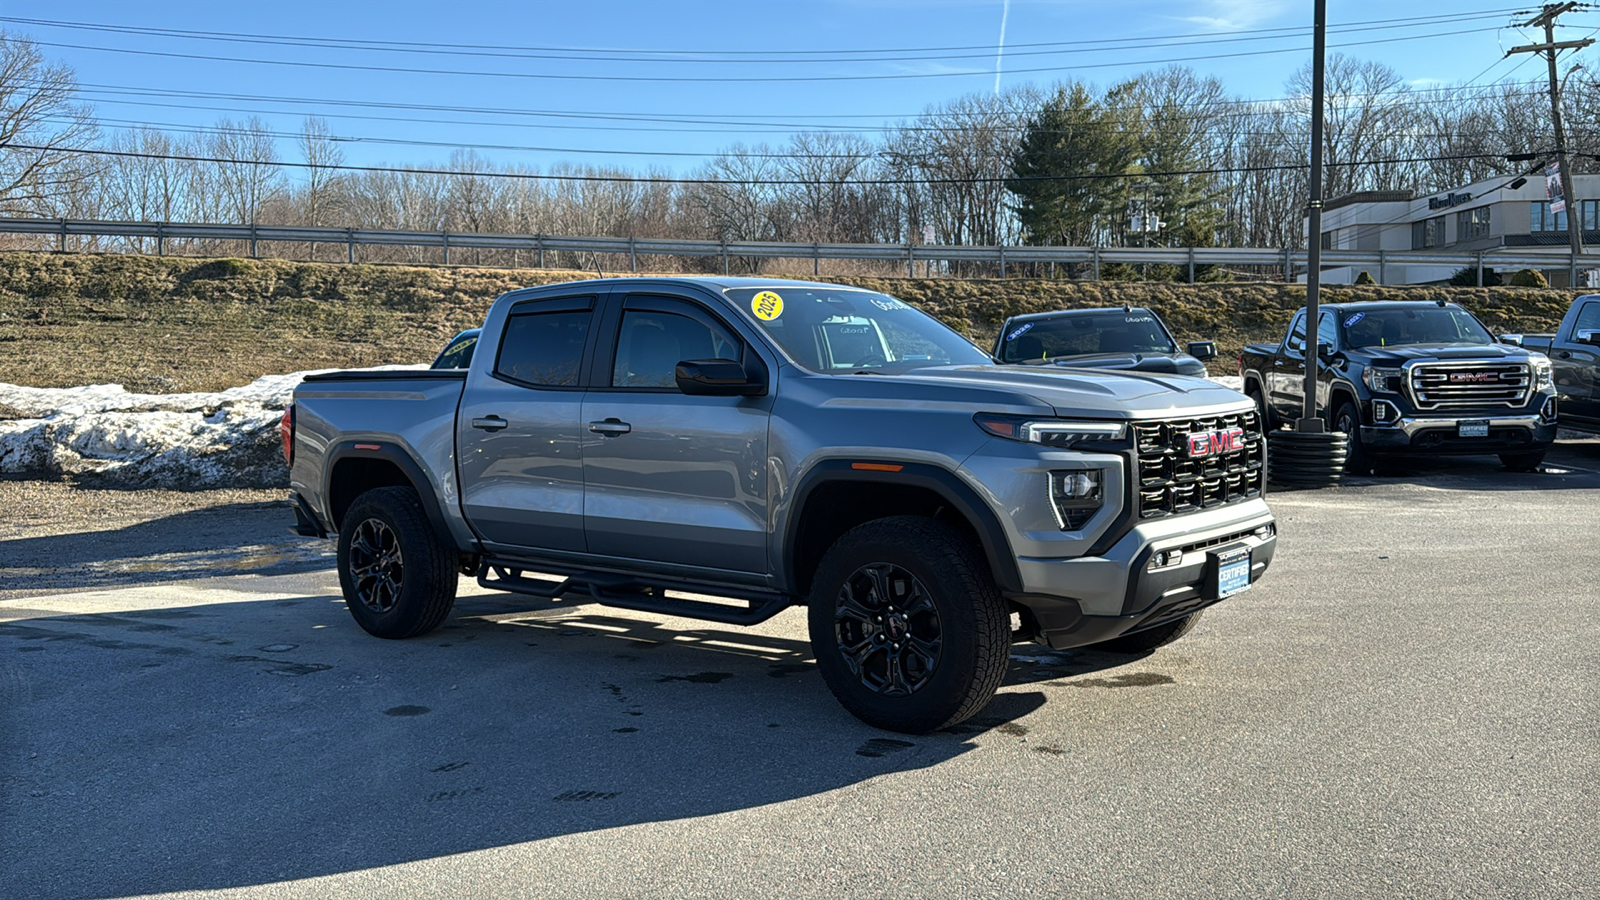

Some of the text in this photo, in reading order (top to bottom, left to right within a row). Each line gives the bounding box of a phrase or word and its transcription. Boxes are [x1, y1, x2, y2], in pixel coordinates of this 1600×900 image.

[1450, 192, 1473, 207] Jones
[757, 293, 777, 318] 2025
[1450, 372, 1498, 382] GMC
[1189, 429, 1243, 456] GMC
[1219, 563, 1249, 582] CERTIFIED
